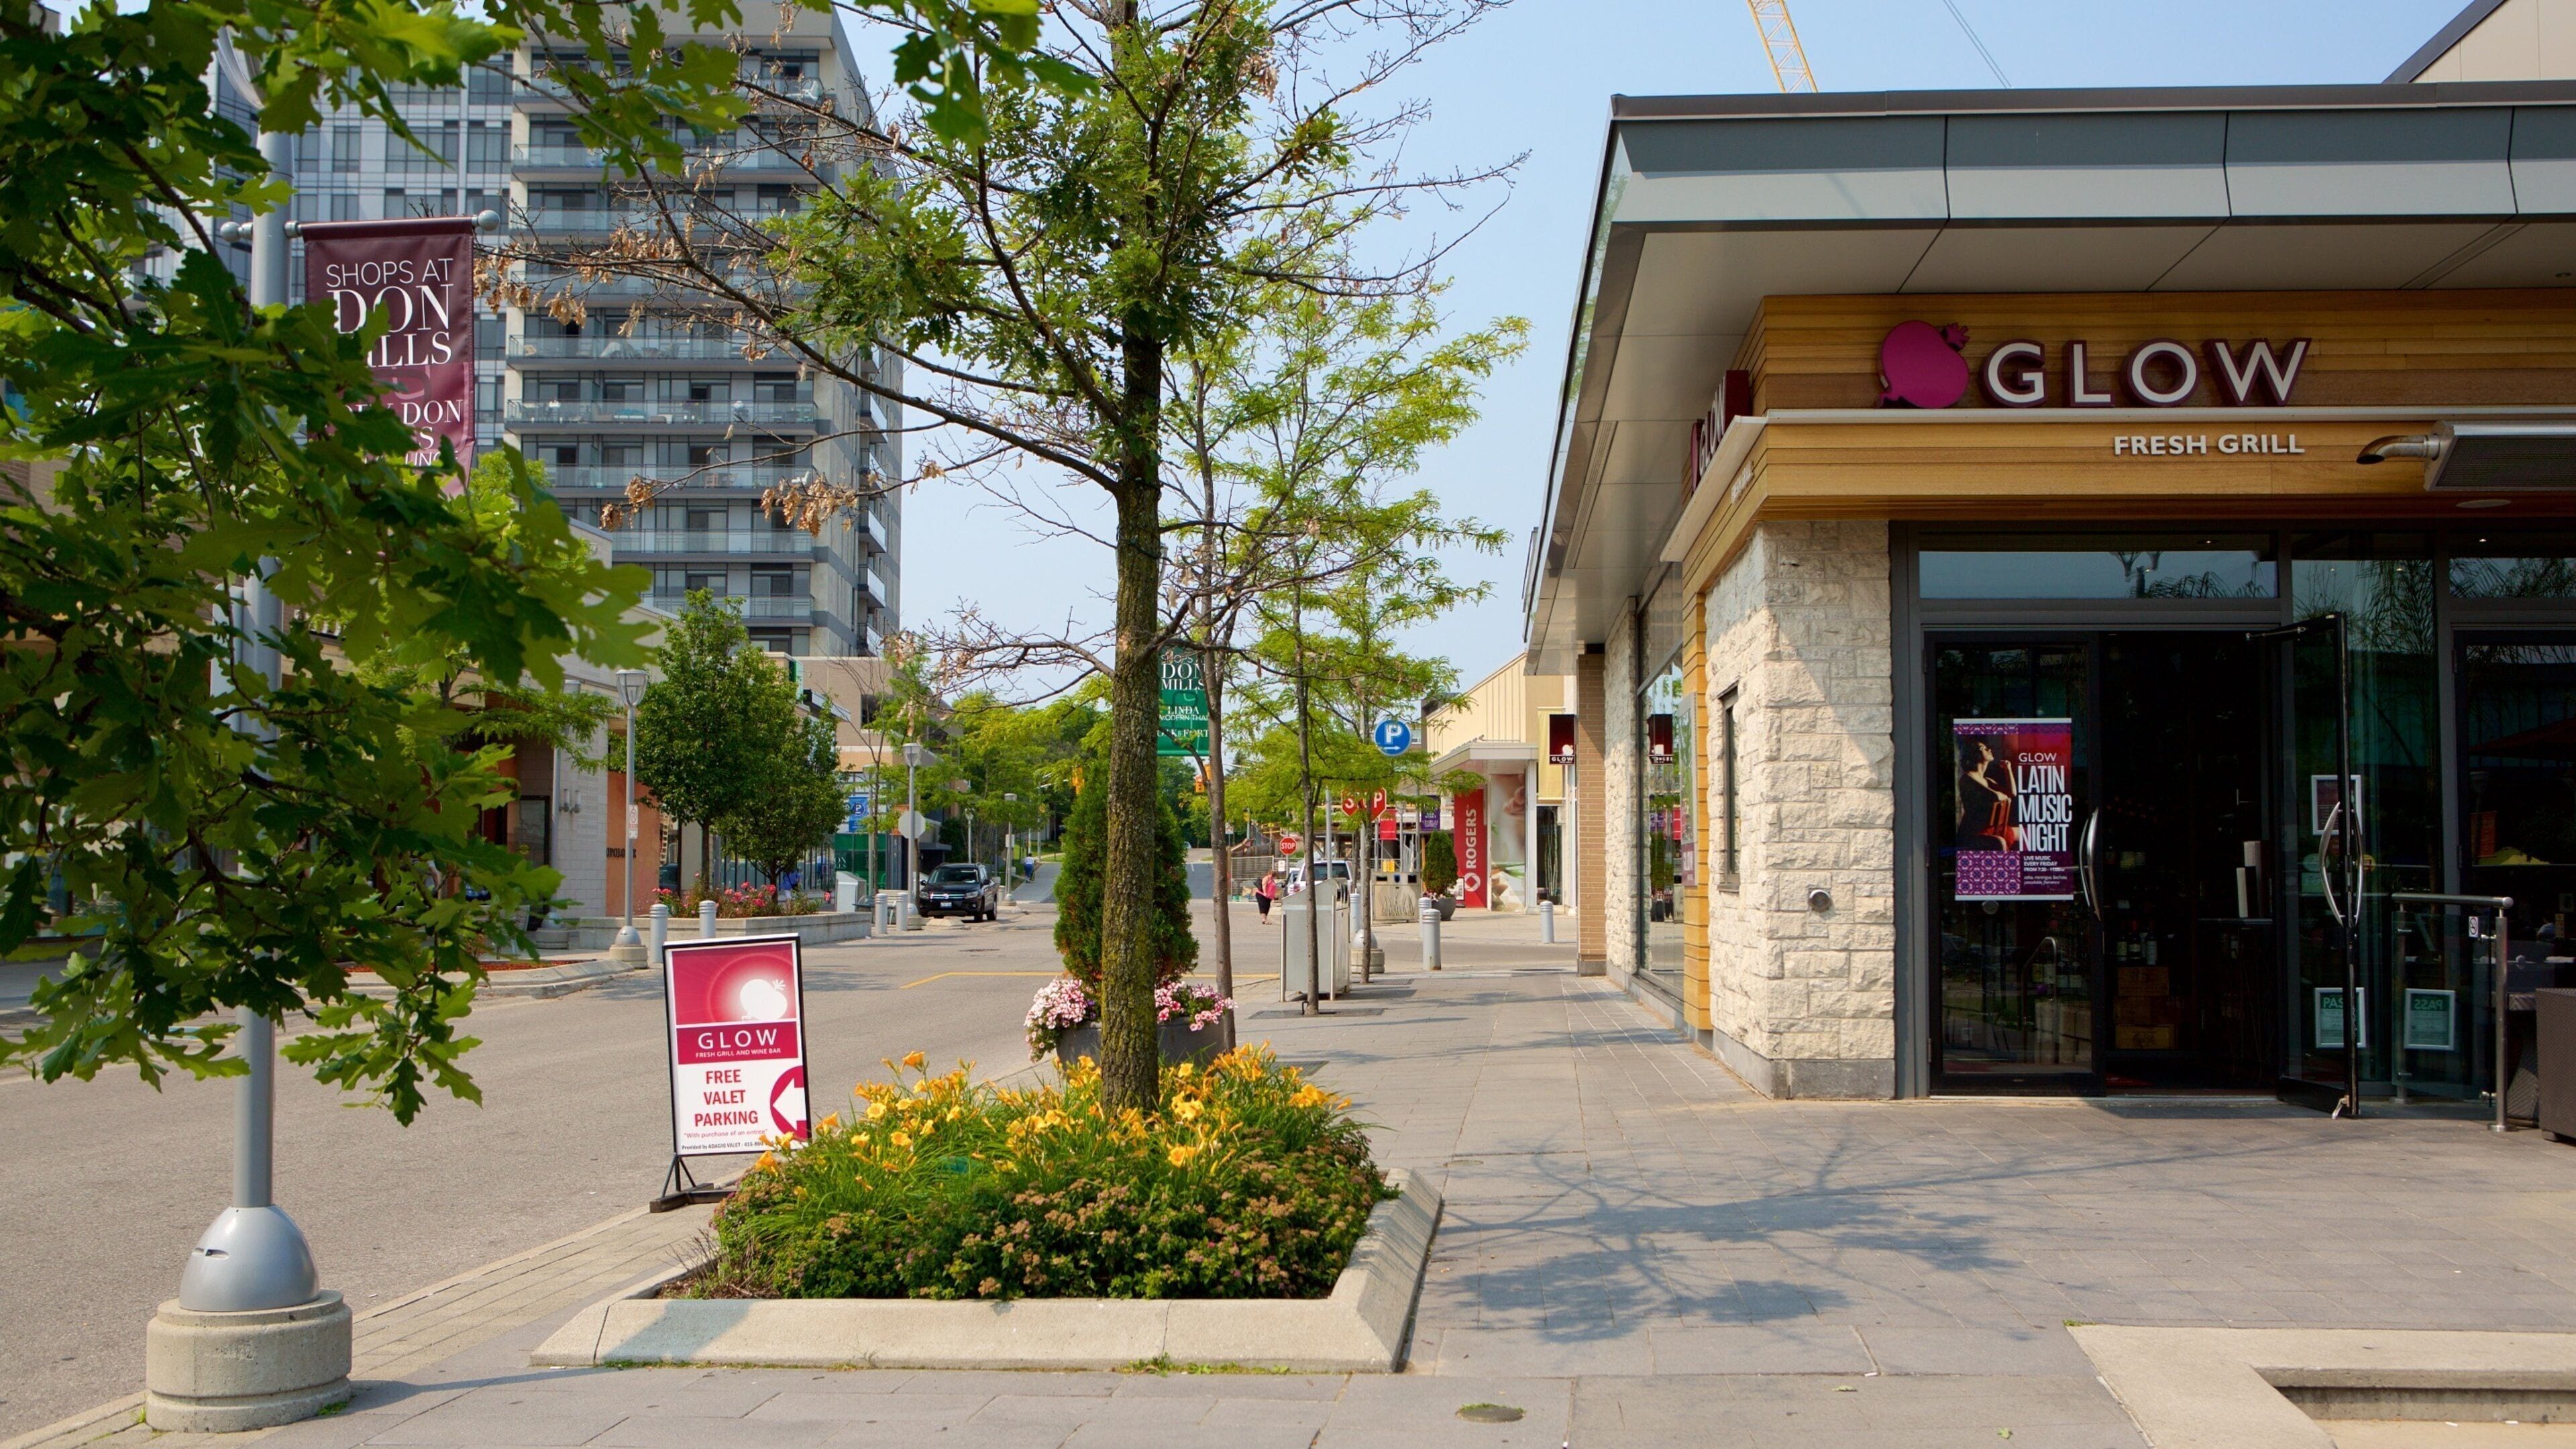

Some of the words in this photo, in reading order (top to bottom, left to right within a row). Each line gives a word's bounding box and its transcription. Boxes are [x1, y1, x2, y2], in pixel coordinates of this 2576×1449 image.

[326, 260, 414, 287] SHOPS
[422, 258, 453, 282] AT
[327, 284, 454, 334] DON
[1984, 337, 2311, 407] GLOW
[401, 399, 464, 425] DON
[2114, 435, 2207, 455] FRESH
[2218, 433, 2306, 453] GRILL
[1161, 654, 1193, 663] SOPS
[1161, 663, 1206, 679] DON
[1161, 678, 1205, 690] MILLS
[1168, 706, 1199, 714] LINDA
[2019, 752, 2057, 762] GLOW
[2018, 765, 2065, 794] LATIN
[1344, 792, 1383, 809] SP
[2018, 794, 2073, 823] MUSIC
[1466, 808, 1477, 869] ROGERS
[2019, 823, 2070, 852] NIGHT
[2323, 997, 2344, 1008] PAS
[698, 1028, 777, 1049] GLOW
[706, 1069, 741, 1085] FREE
[704, 1089, 746, 1106] VALET
[694, 1110, 759, 1127] PARKING
[702, 1131, 729, 1139] purchase
